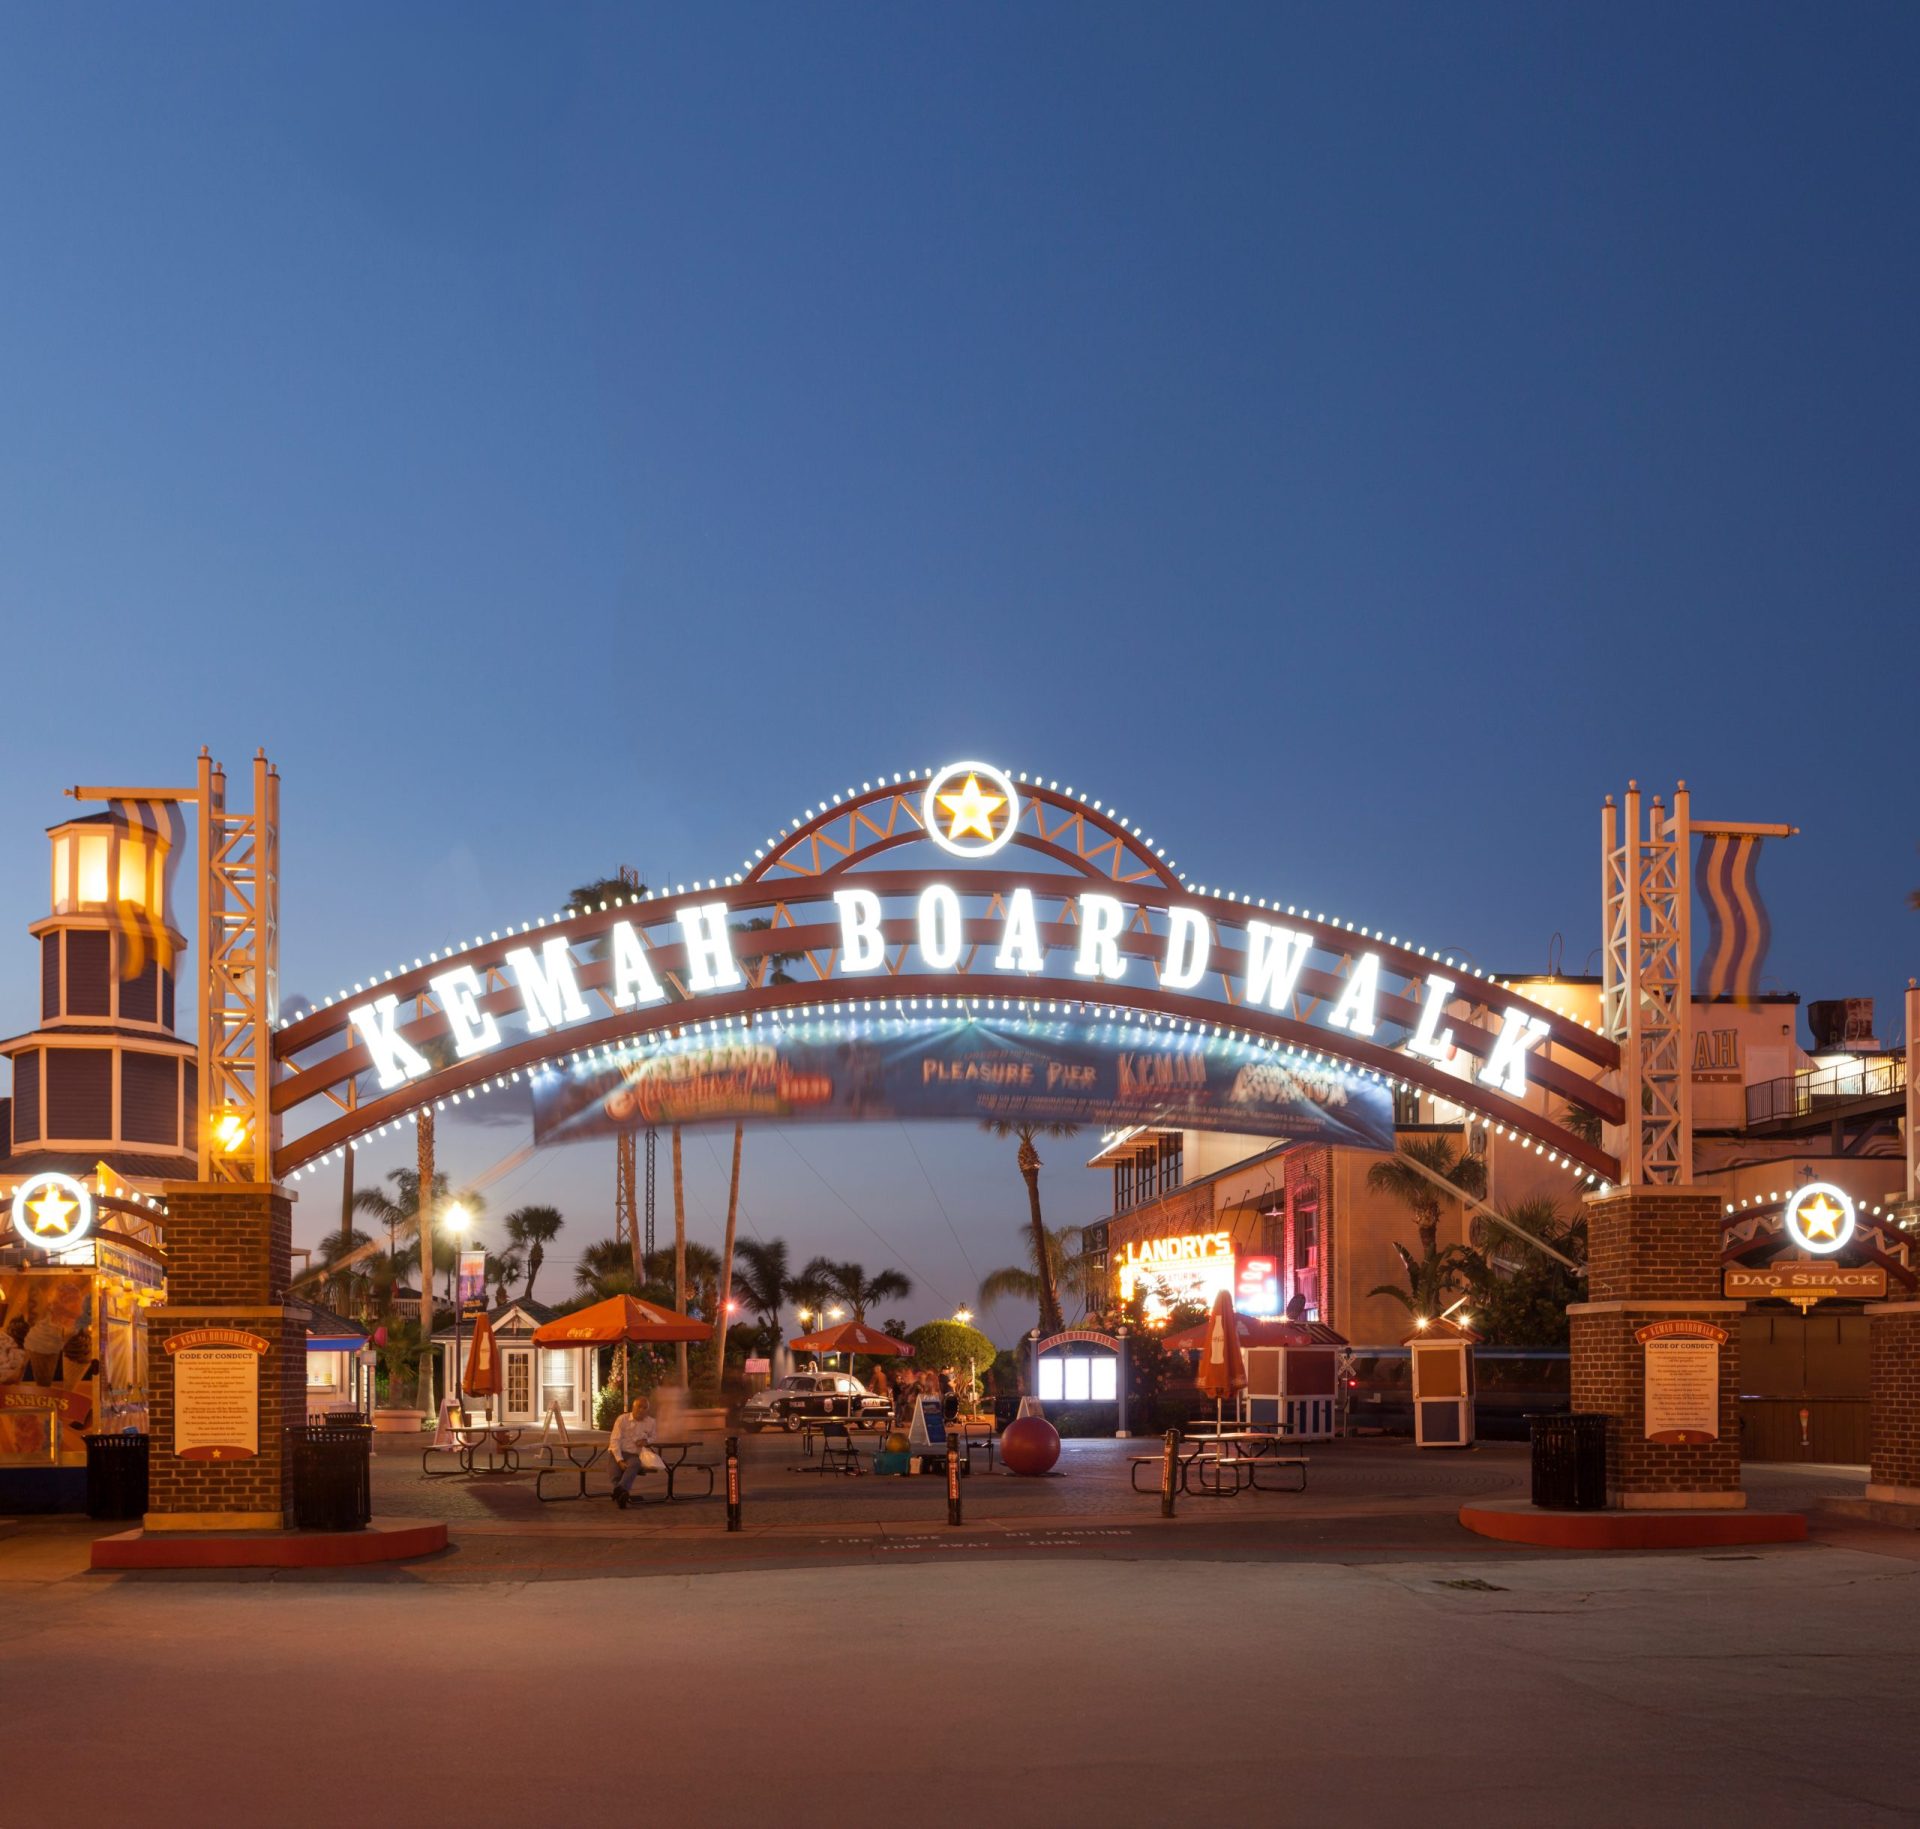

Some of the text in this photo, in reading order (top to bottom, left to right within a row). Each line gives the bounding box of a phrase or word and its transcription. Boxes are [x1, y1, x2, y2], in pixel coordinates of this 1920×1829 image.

[348, 884, 1551, 1098] KEMAH BOARDWALK
[1127, 1231, 1231, 1264] LANDRY'S
